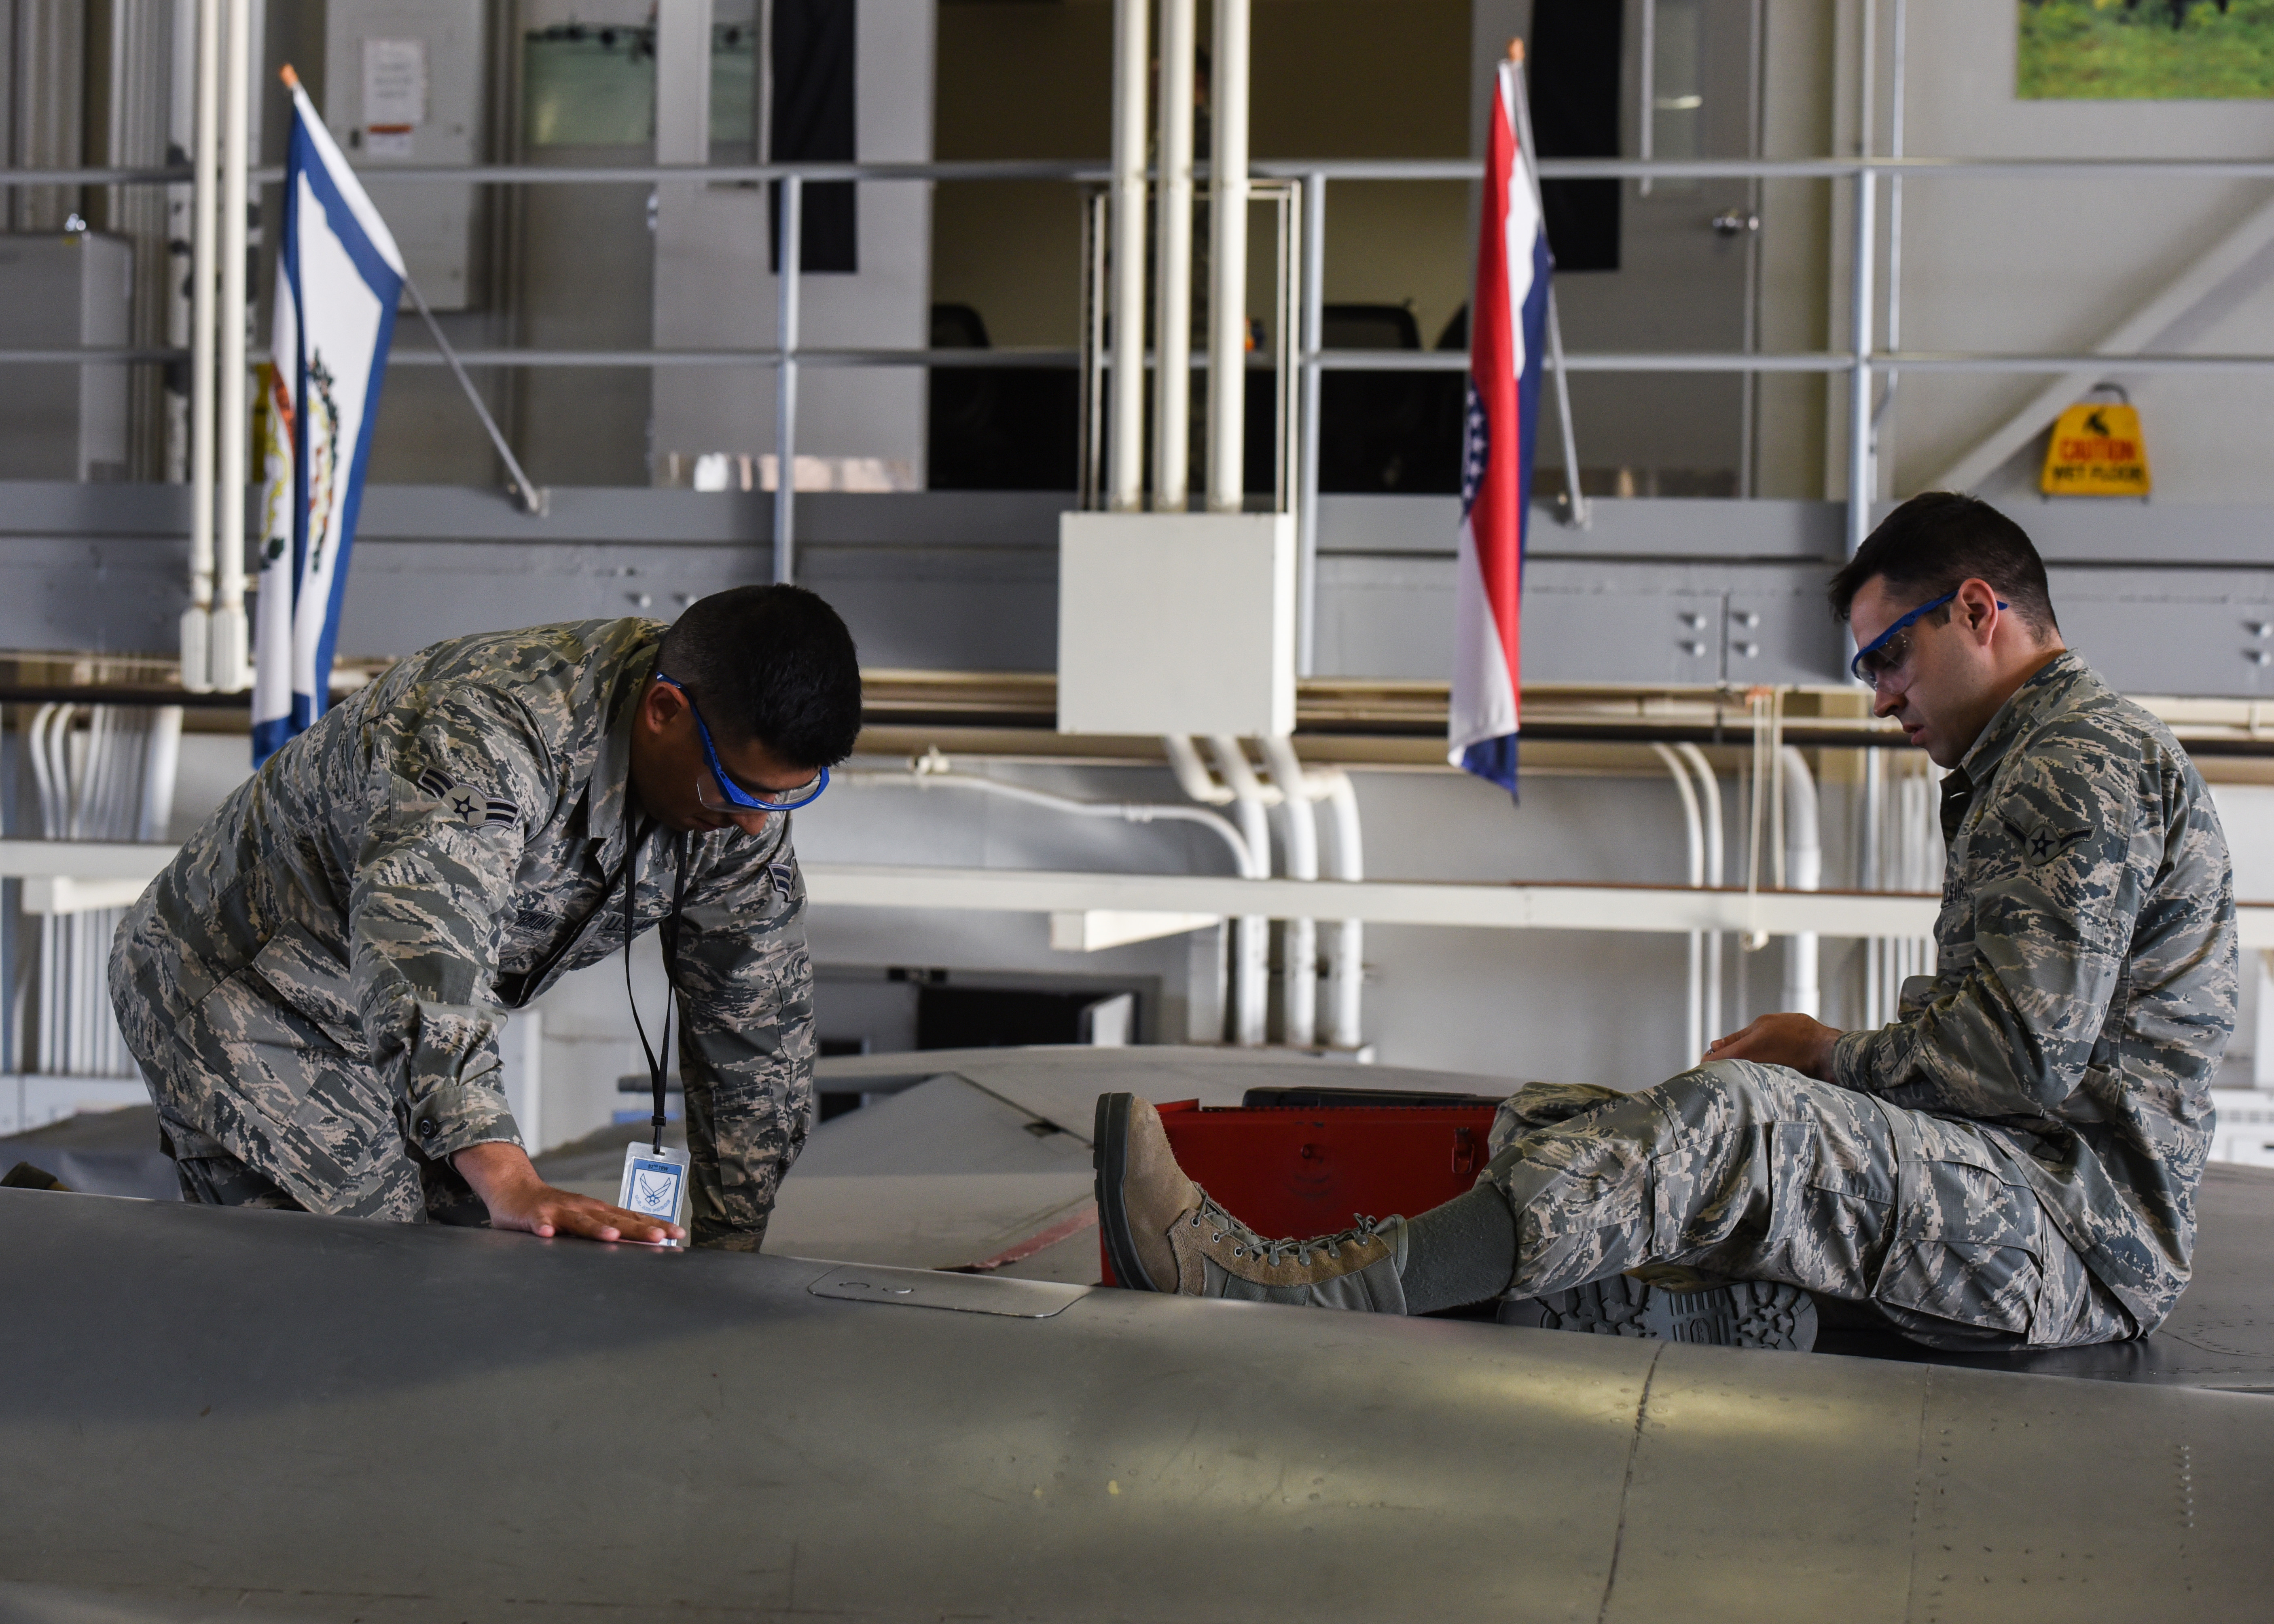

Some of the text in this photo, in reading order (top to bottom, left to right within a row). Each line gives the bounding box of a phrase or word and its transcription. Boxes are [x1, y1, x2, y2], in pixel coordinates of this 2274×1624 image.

[2060, 438, 2136, 461] CAUTION
[2053, 466, 2085, 481] WET
[652, 1199, 671, 1212] FORCE
